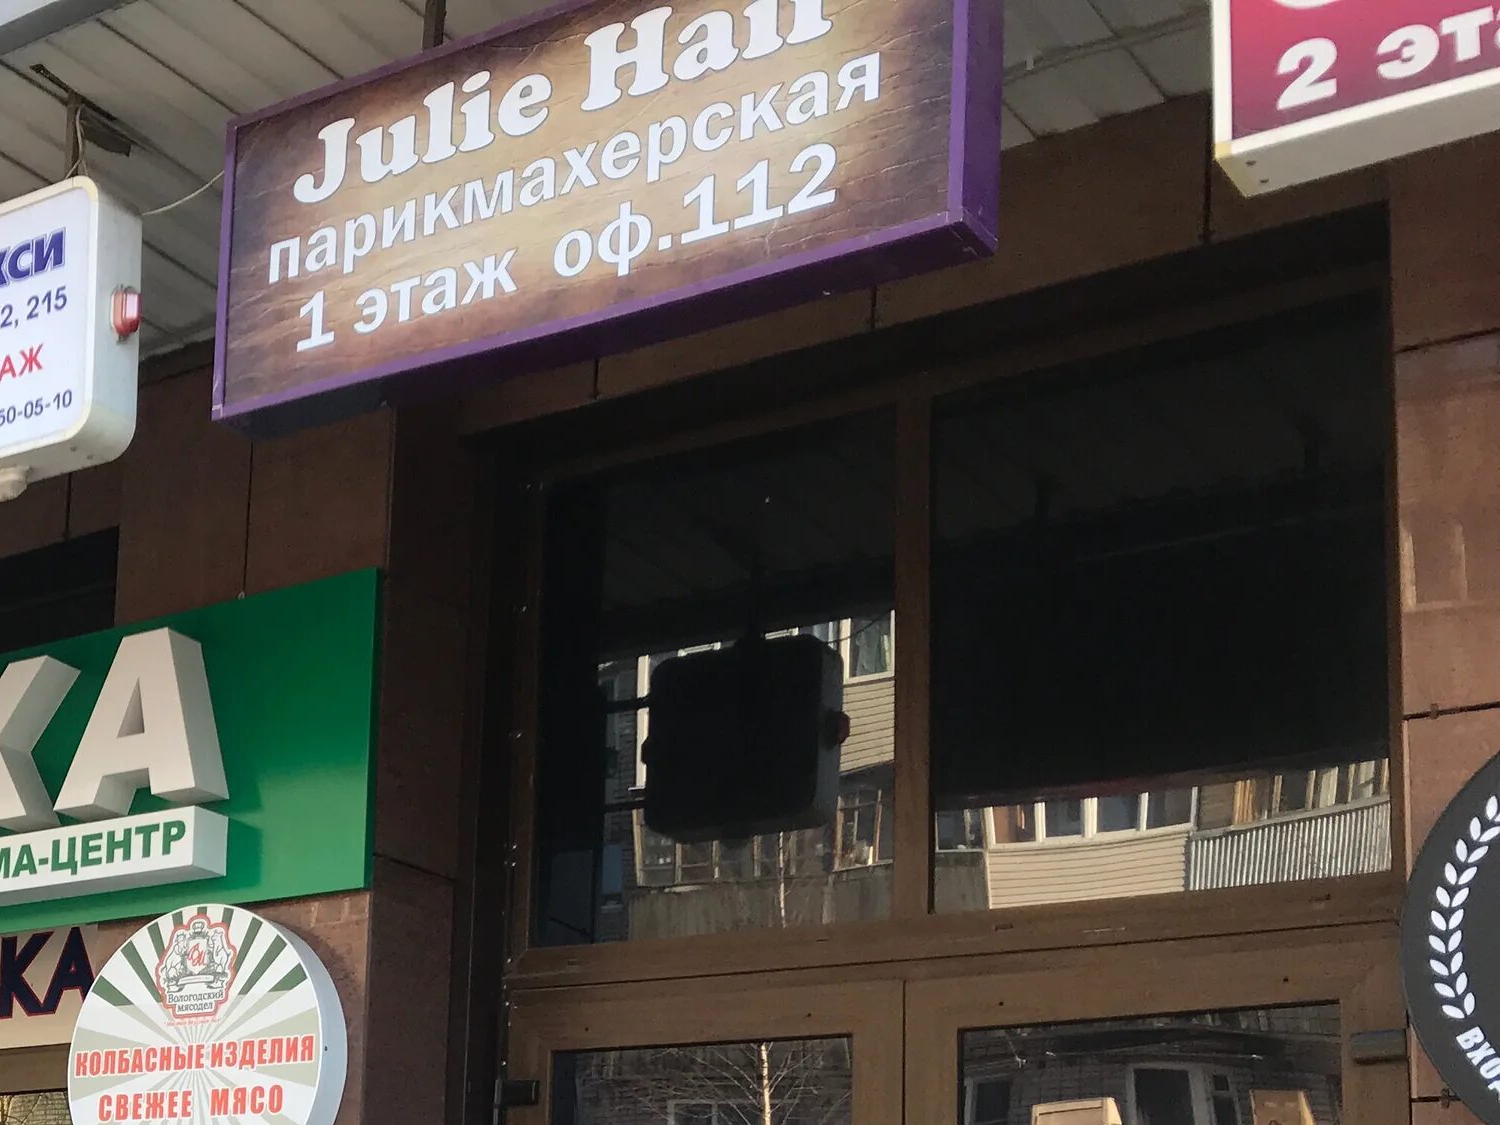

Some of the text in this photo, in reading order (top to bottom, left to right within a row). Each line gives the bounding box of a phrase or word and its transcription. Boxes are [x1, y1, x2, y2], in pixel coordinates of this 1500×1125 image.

[1276, 5, 1500, 111] 2 эт
[292, 69, 553, 204] Julie
[268, 51, 882, 284] парикмахерская
[295, 142, 839, 353] 1 этаж оф.112
[26, 285, 68, 321] 215
[168, 990, 224, 1004] Вологодский
[177, 1002, 213, 1013] мясодел
[75, 1035, 315, 1077] КОЛБАСНЫЕ ИЗДЕЛИЯ
[1456, 1026, 1500, 1104] ВХО
[98, 1084, 283, 1122] СВЕЖЕЕ МЯСО
